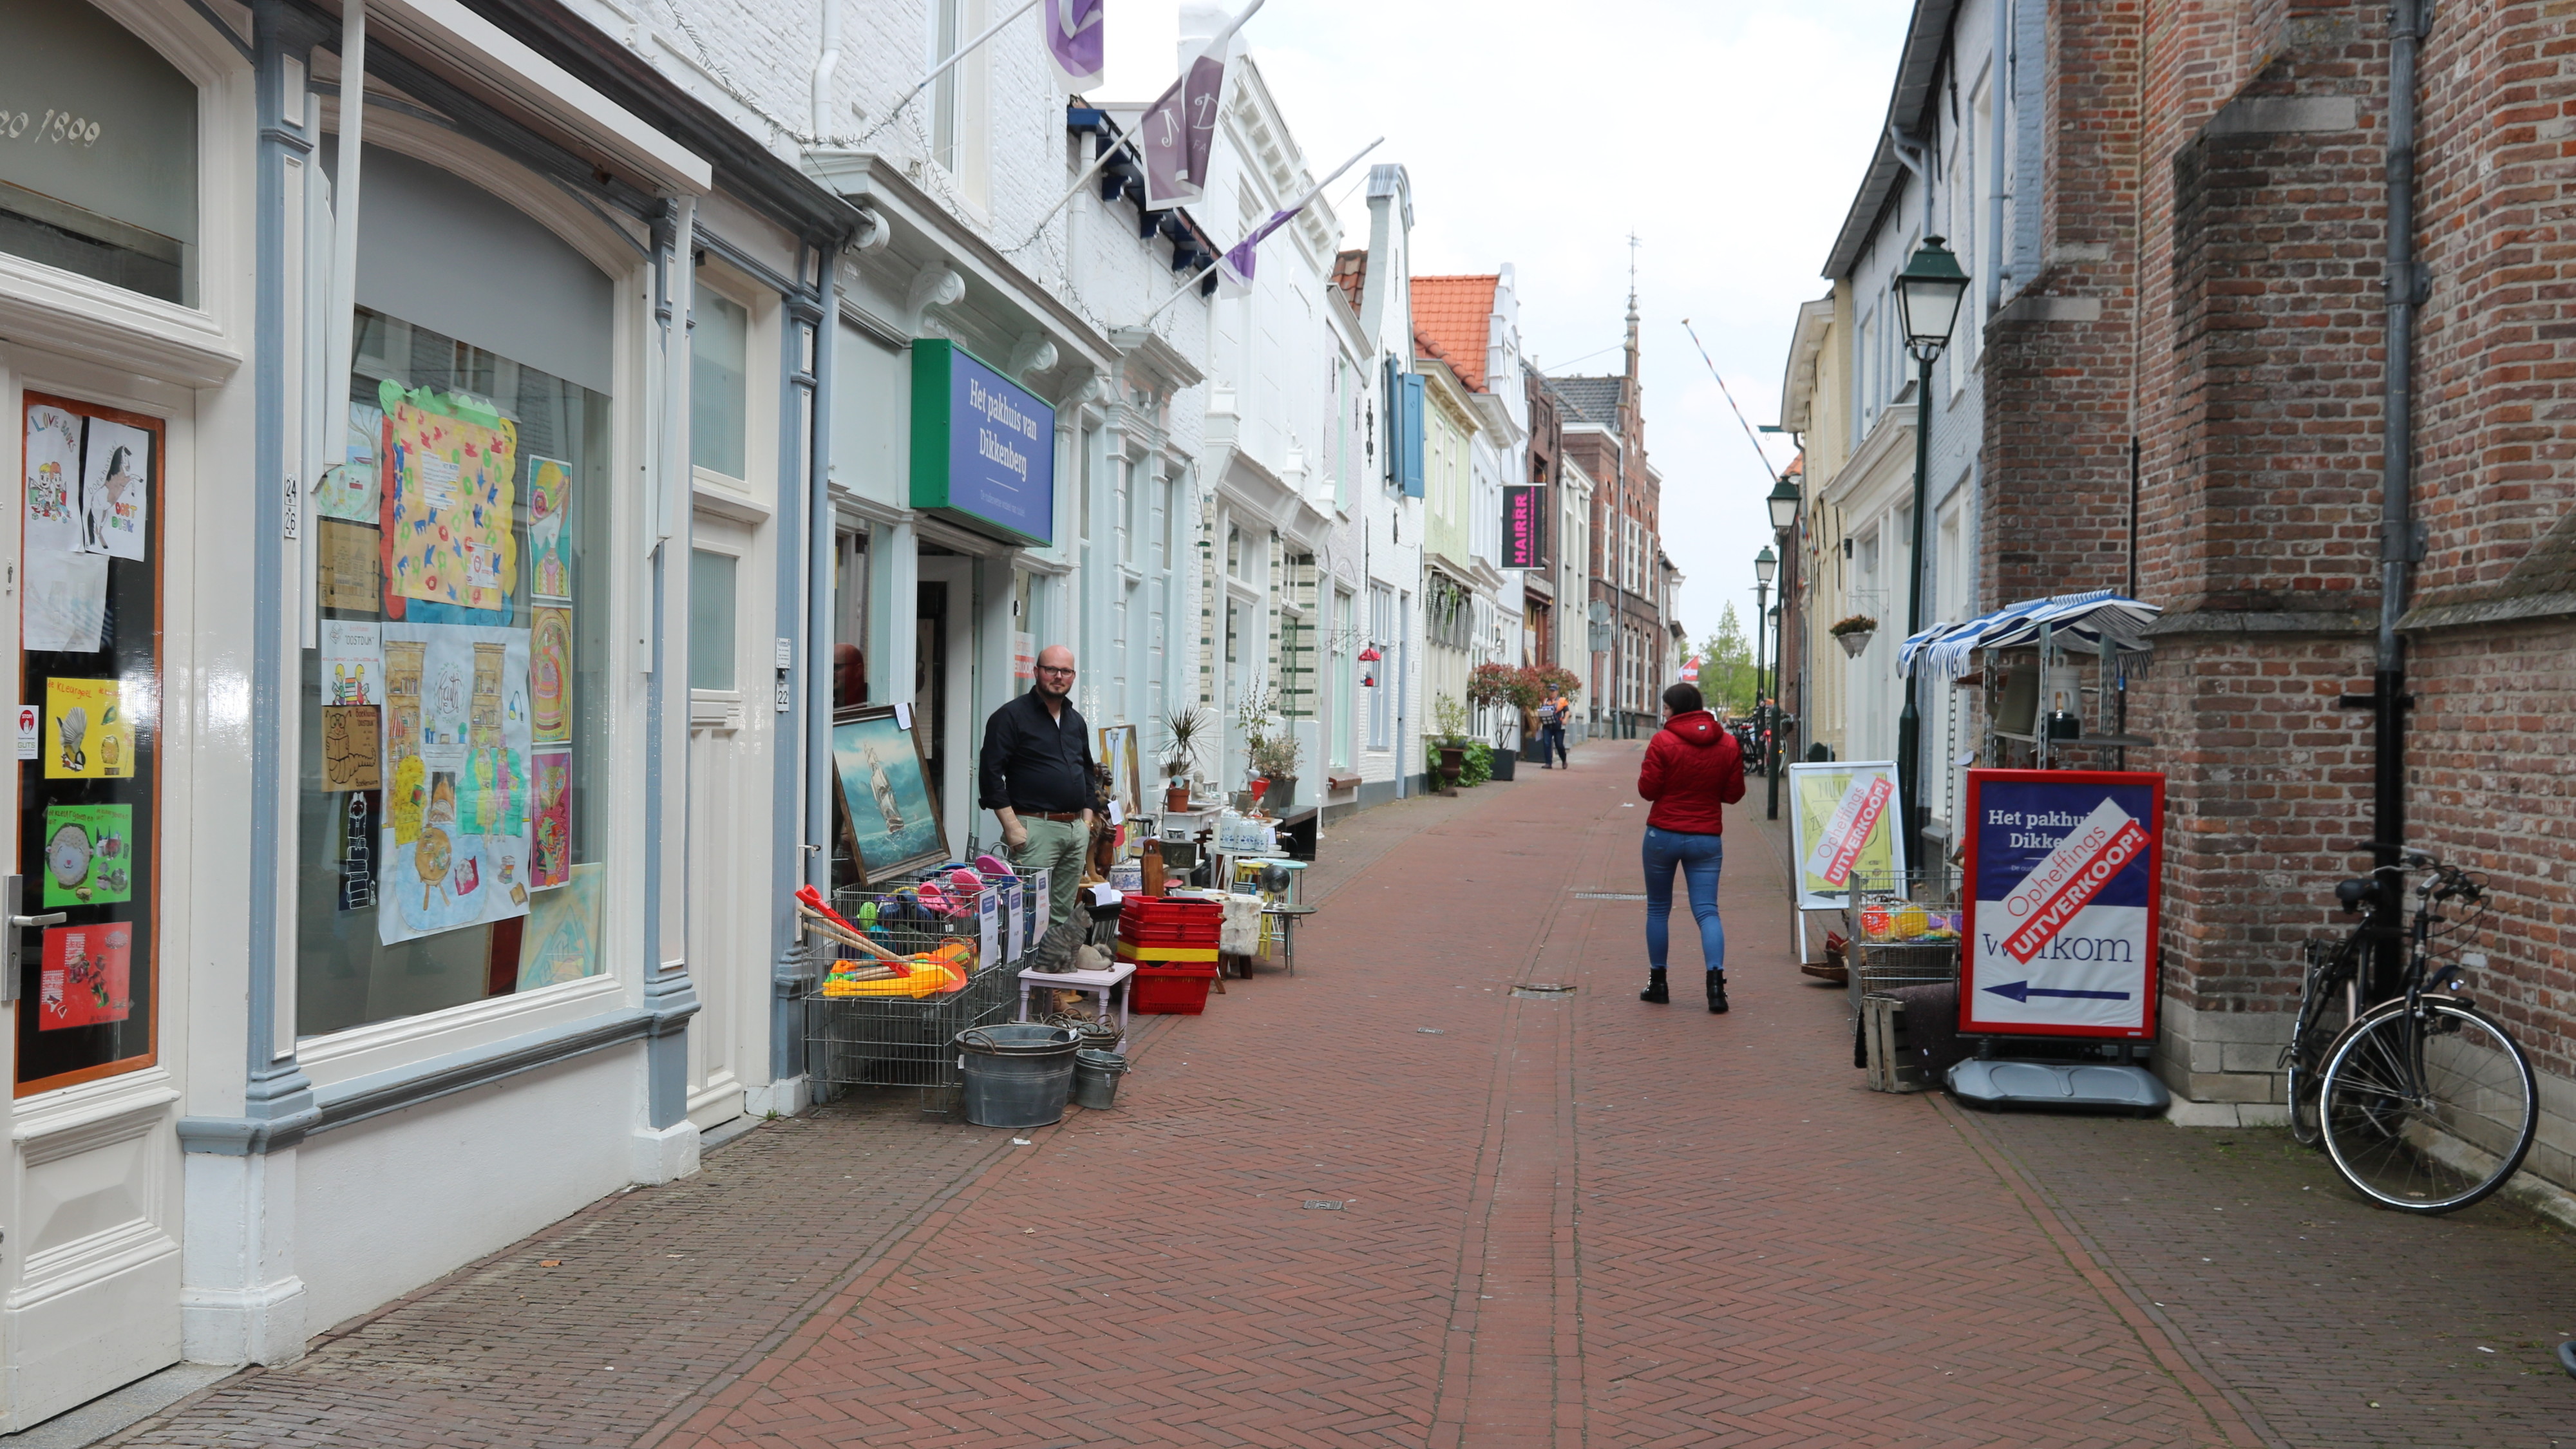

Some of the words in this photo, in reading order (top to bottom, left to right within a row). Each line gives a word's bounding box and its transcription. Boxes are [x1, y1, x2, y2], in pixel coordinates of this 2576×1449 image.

[31, 412, 59, 432] LOVE
[60, 420, 77, 453] BOOKS
[970, 377, 986, 413] Het
[987, 392, 1021, 432] pakhuis
[1023, 415, 1037, 441] van
[979, 427, 1027, 482] Dikkenberg
[286, 478, 296, 498] 24
[285, 512, 296, 531] 26
[1513, 491, 1528, 564] HAIRRR
[777, 690, 788, 705] 22
[1818, 786, 1865, 858] Opheffings
[1830, 782, 1889, 882] UITVERKOOP!
[1988, 810, 2022, 825] Het
[2025, 810, 2092, 829] pakhu
[2009, 833, 2067, 849] Dikke
[2007, 826, 2107, 917] Opheffings
[2012, 828, 2144, 955] UITVERKOOP!
[1982, 931, 2133, 963] Wlkom
